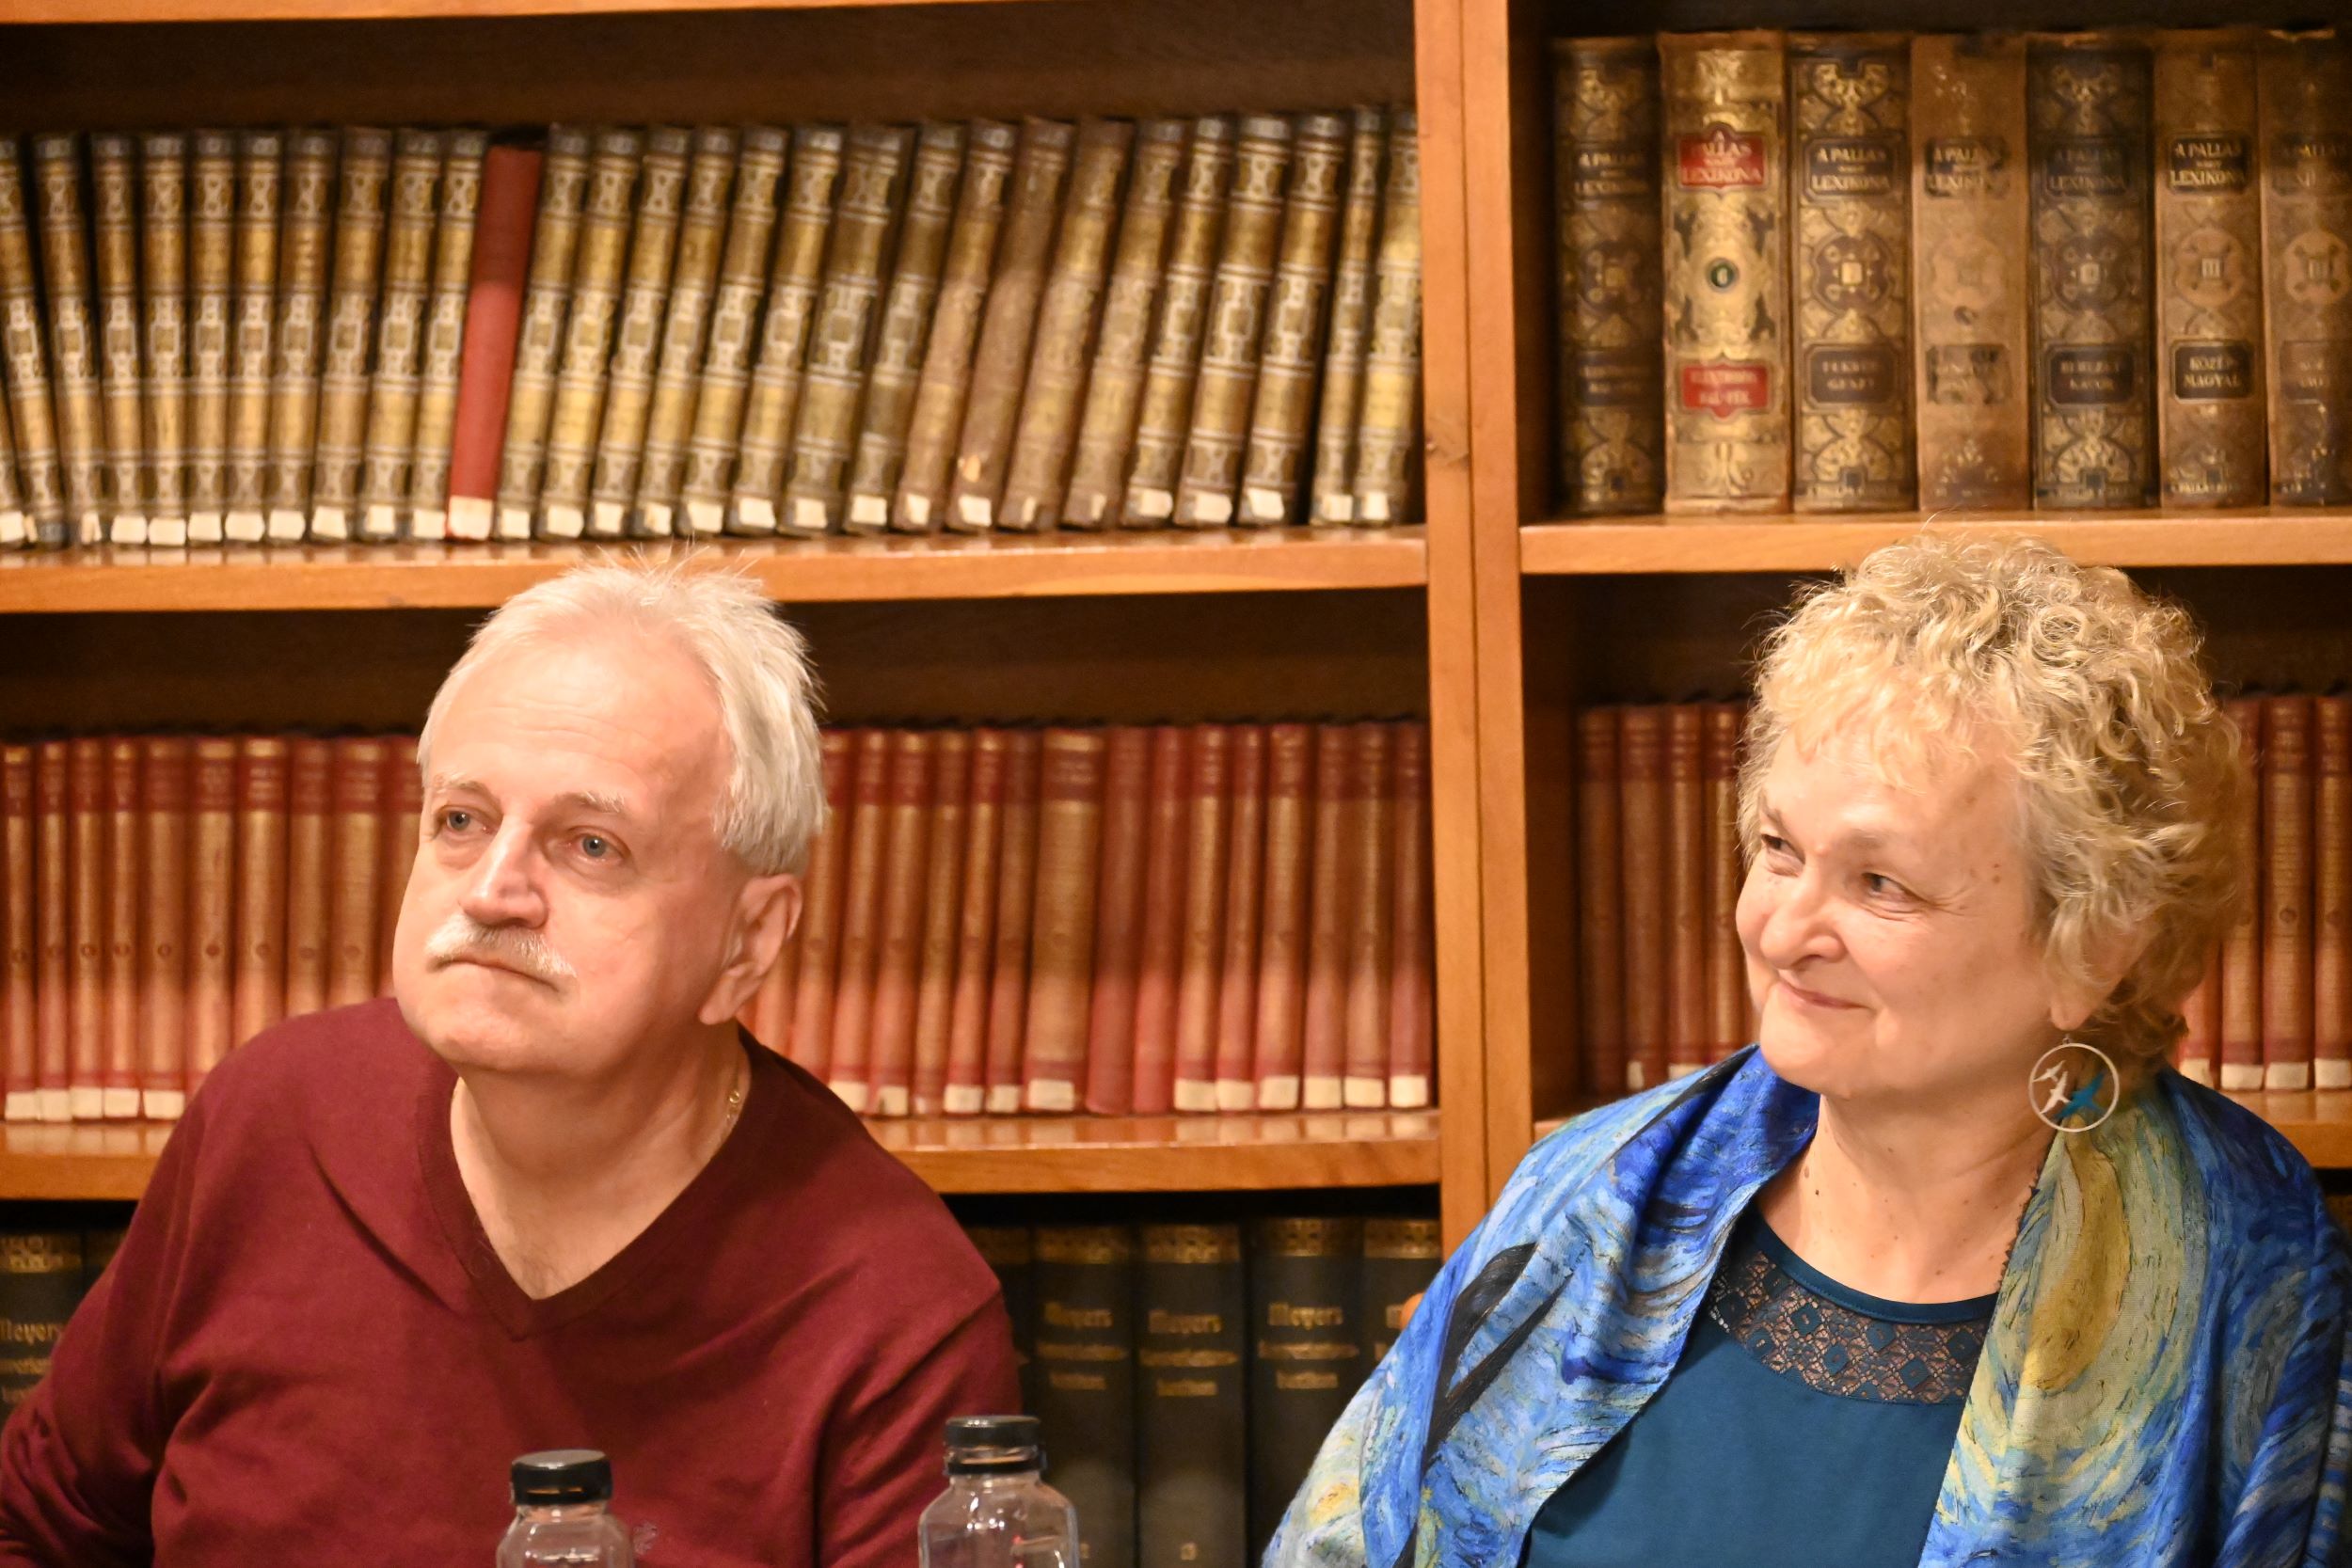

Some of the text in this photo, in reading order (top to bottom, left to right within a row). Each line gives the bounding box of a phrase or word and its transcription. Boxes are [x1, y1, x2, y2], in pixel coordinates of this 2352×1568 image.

[1817, 148, 1886, 163] A PALLAS
[2175, 142, 2186, 158] A
[1812, 174, 1891, 191] LEXIKONA
[2169, 169, 2246, 186] LEXIKONA
[0, 1319, 64, 1345] eyer
